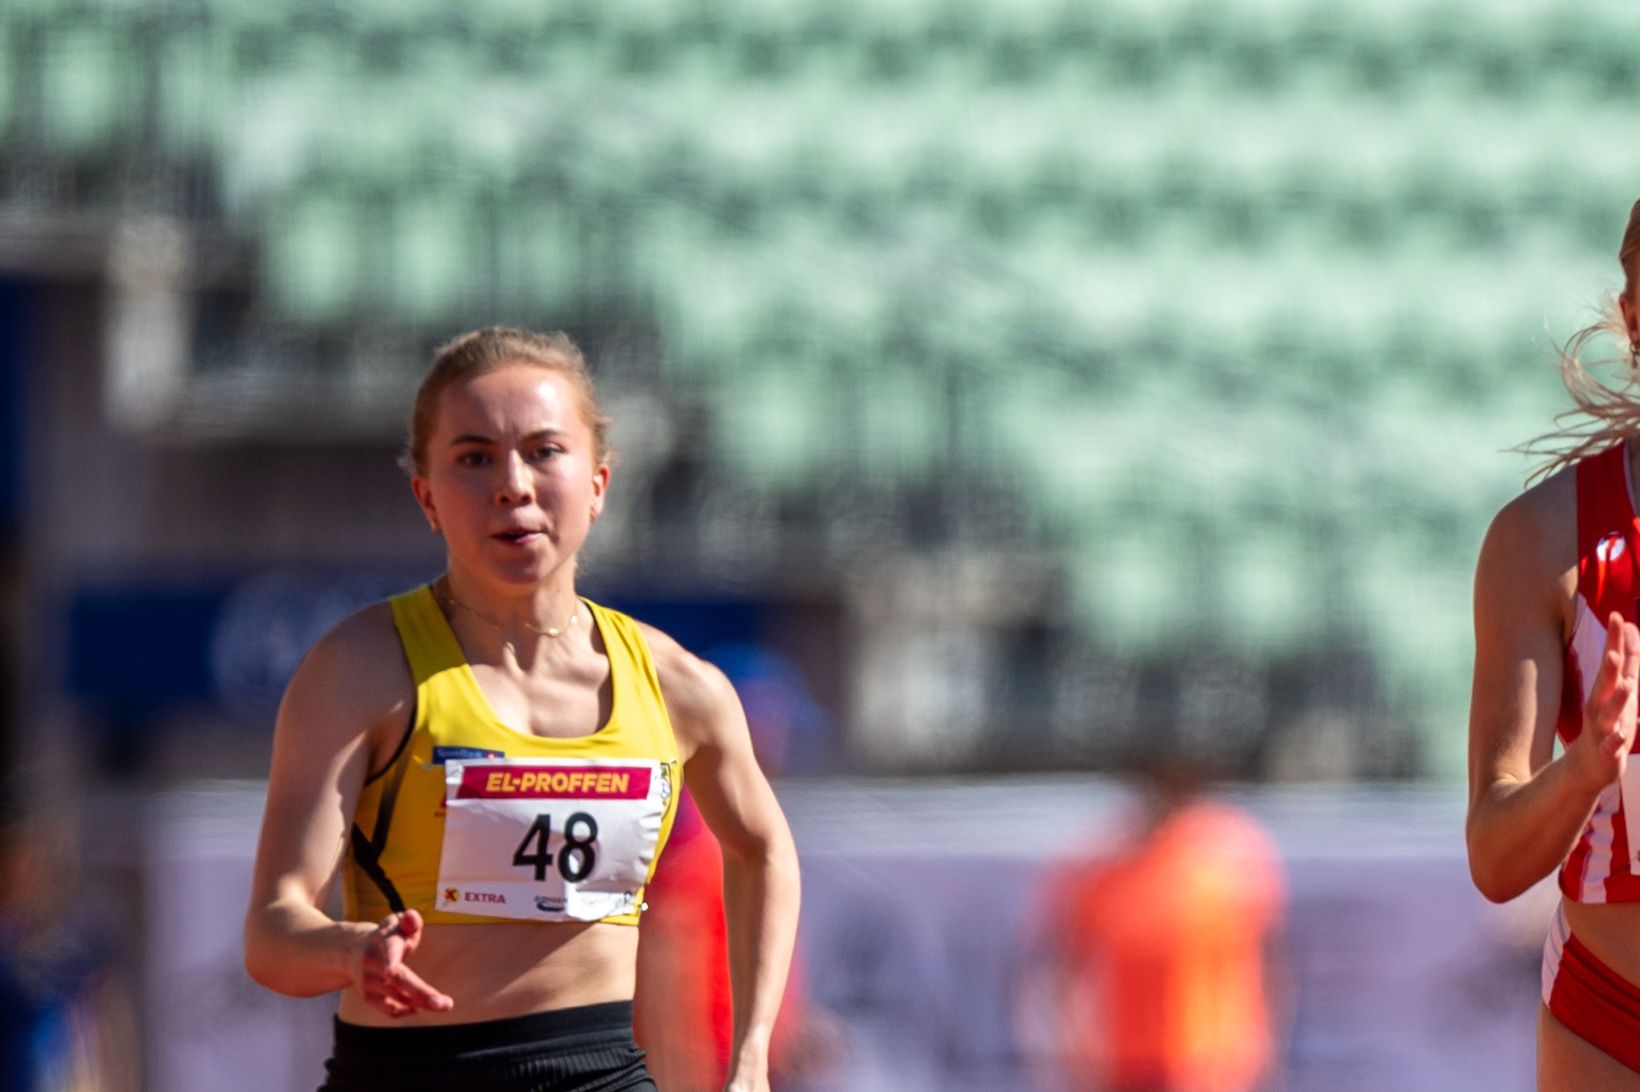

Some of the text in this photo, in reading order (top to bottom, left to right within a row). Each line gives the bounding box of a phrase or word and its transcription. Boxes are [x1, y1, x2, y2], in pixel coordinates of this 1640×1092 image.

[485, 772, 630, 794] EL-PROFFEN
[512, 811, 599, 883] 48
[463, 891, 507, 905] EXTRA
